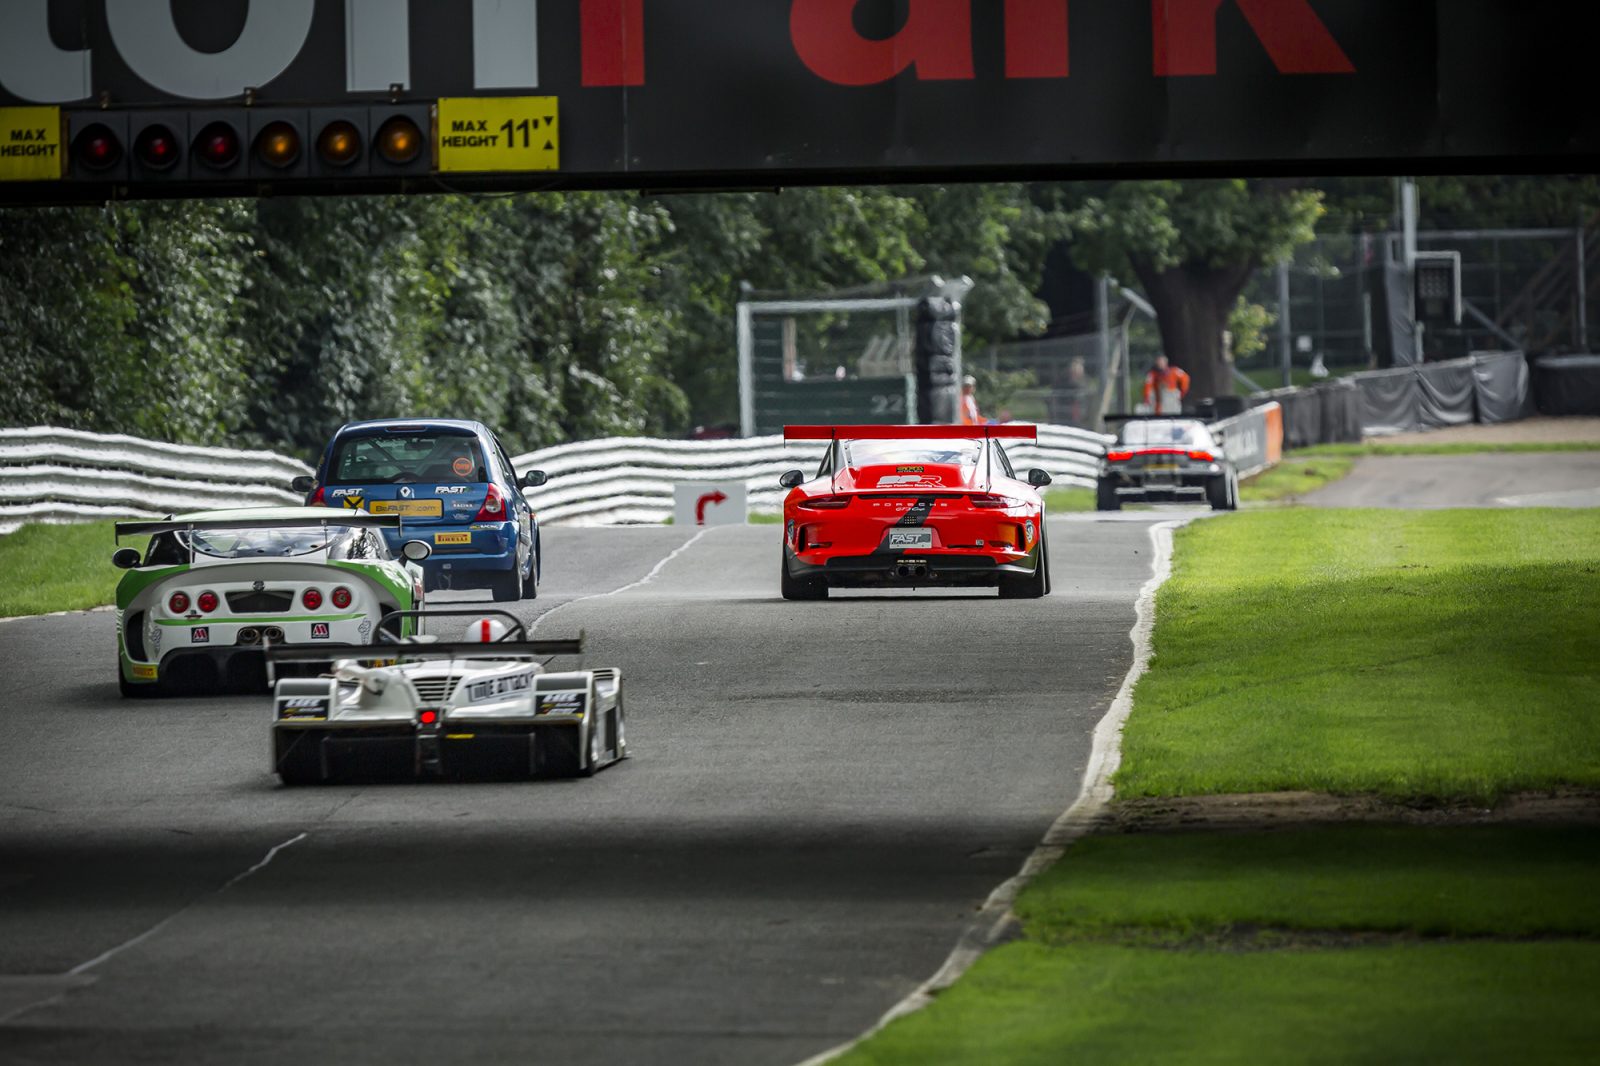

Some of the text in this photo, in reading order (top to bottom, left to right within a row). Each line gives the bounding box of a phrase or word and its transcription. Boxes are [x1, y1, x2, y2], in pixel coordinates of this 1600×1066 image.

[451, 120, 488, 132] MAX
[10, 128, 46, 141] MAX
[442, 135, 499, 147] HEIGHT
[0, 144, 58, 156] HEIGHT
[331, 488, 362, 497] FAST
[434, 486, 466, 494] FAST
[437, 533, 469, 543] PIRELLI
[891, 534, 922, 544] FAST
